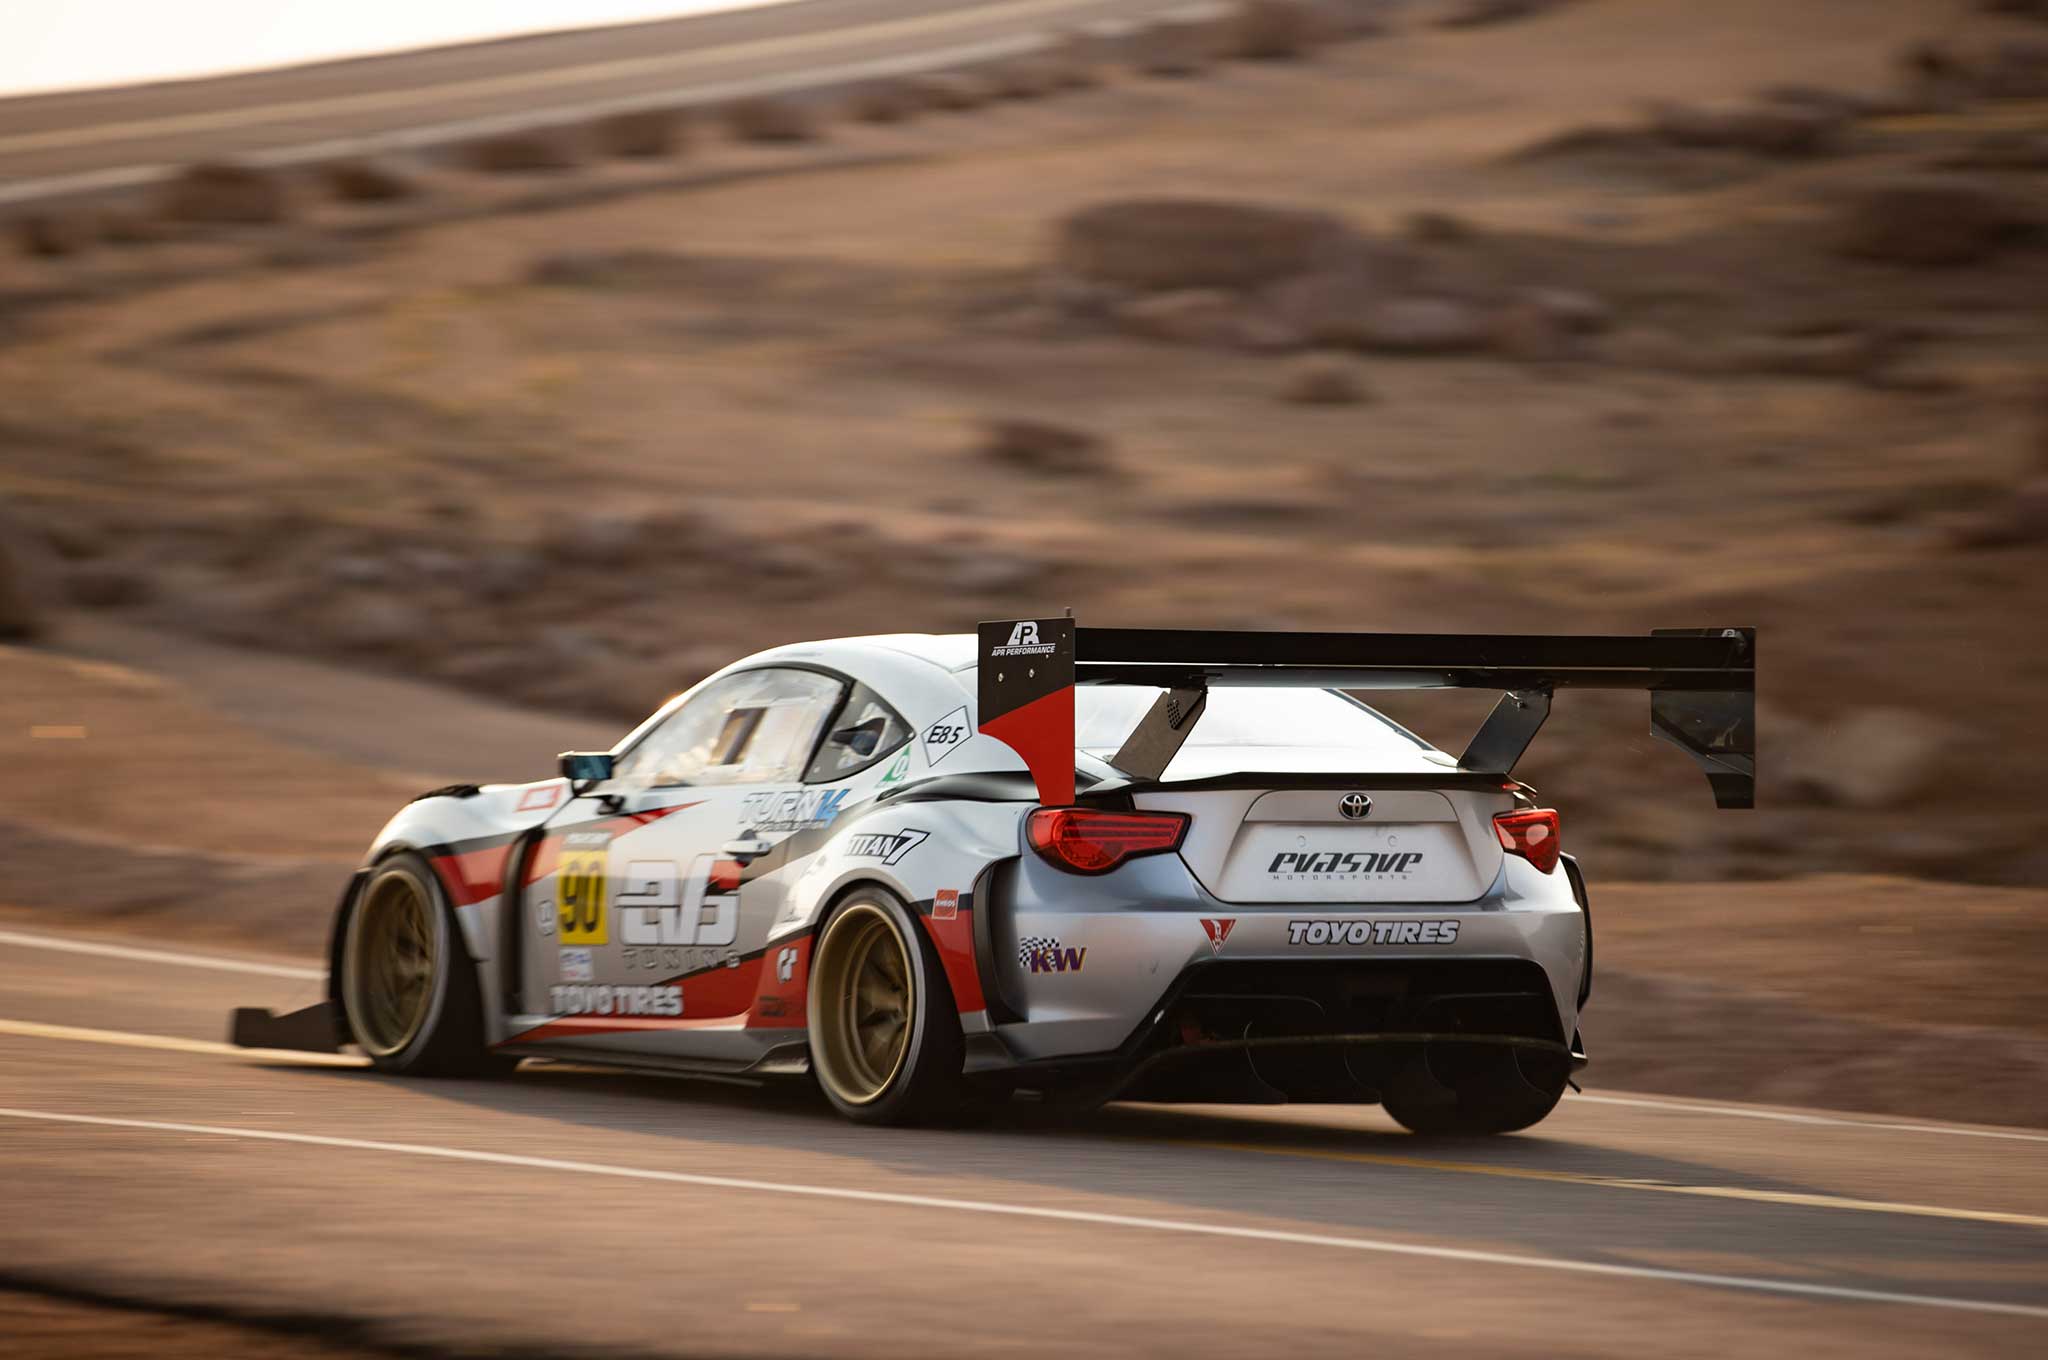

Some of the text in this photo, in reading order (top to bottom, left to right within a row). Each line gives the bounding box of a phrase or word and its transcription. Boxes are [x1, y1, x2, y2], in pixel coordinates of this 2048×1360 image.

[991, 646, 1056, 657] APR PERFORMANCE
[927, 725, 965, 744] E85
[560, 860, 604, 933] 90
[1288, 920, 1461, 945] TOYO TIRES
[623, 948, 741, 969] TUNING
[1030, 947, 1088, 974] KW
[550, 985, 683, 1016] TOYO TIRES
